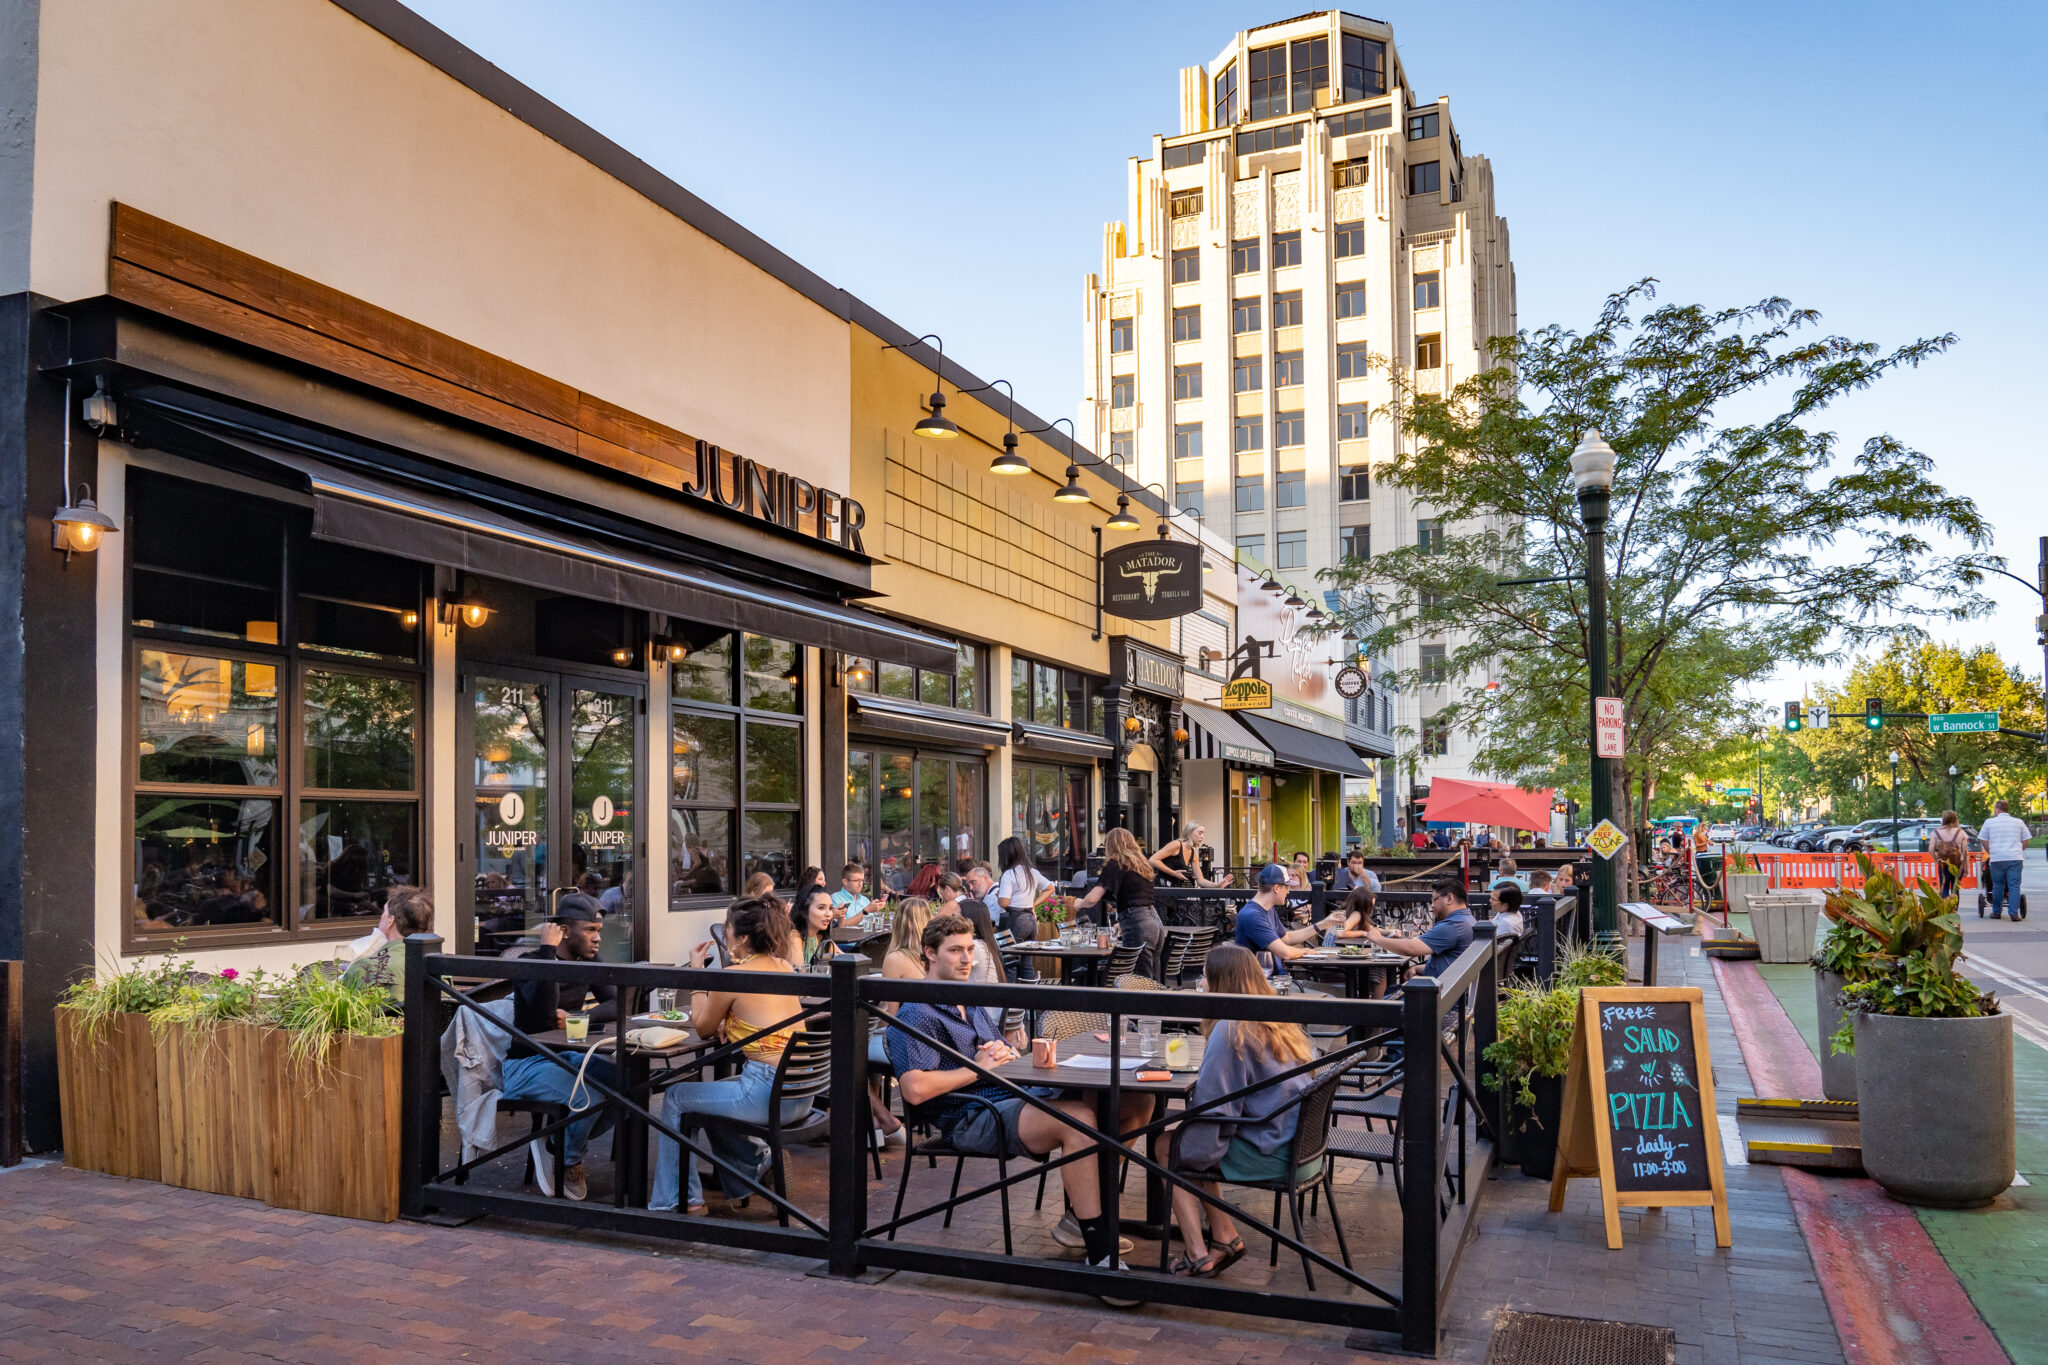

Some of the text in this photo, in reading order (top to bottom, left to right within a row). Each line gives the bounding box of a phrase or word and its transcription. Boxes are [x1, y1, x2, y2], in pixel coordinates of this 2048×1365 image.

[682, 439, 866, 555] JUNIPER
[1126, 556, 1176, 571] MATADOR
[1136, 656, 1178, 690] MATADOR
[501, 686, 523, 704] 211
[1225, 681, 1267, 701] Zeppole
[594, 698, 612, 714] 211
[1604, 704, 1615, 715] NO
[1598, 717, 1622, 728] PARKING
[1943, 720, 1985, 731] Bannock
[1605, 732, 1616, 740] FIRE
[1604, 743, 1617, 752] LANE
[507, 798, 516, 820] J
[599, 801, 607, 820] J
[485, 831, 537, 846] JUNIPER
[580, 831, 625, 845] JUNIPER
[1593, 836, 1622, 848] ZONE
[1623, 1025, 1681, 1053] SALAD
[1608, 1091, 1693, 1130] PIZZA
[1636, 1134, 1677, 1160] daily
[1633, 1160, 1687, 1177] 11:00-3:00
